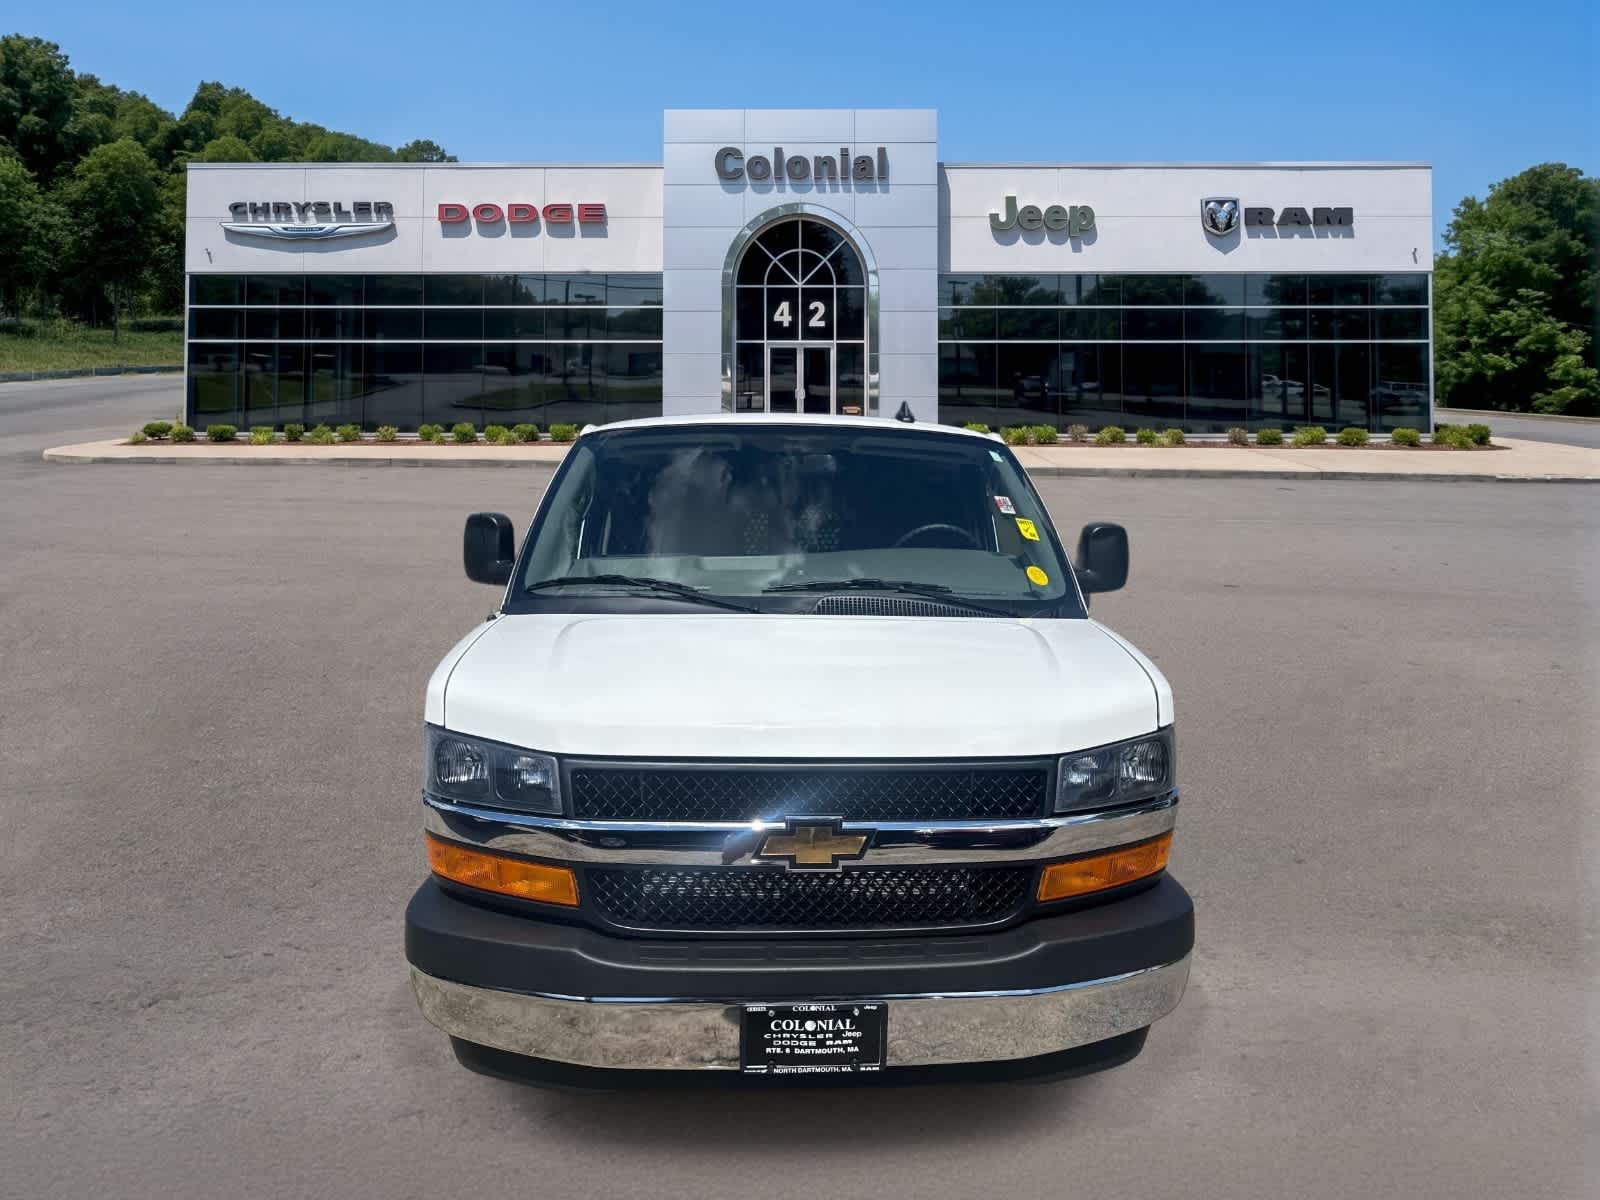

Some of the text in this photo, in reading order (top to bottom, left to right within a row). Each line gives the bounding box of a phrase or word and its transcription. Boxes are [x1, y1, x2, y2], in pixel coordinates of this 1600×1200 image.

[714, 147, 888, 180] Colonial
[228, 200, 394, 217] CHRYSLER
[438, 203, 607, 223] DODGE
[989, 195, 1096, 237] Jeep
[1244, 207, 1354, 226] RAM
[770, 1018, 856, 1032] COLONIAL
[841, 1030, 863, 1038] Jeep
[794, 1047, 846, 1055] DARTMOUTH,
